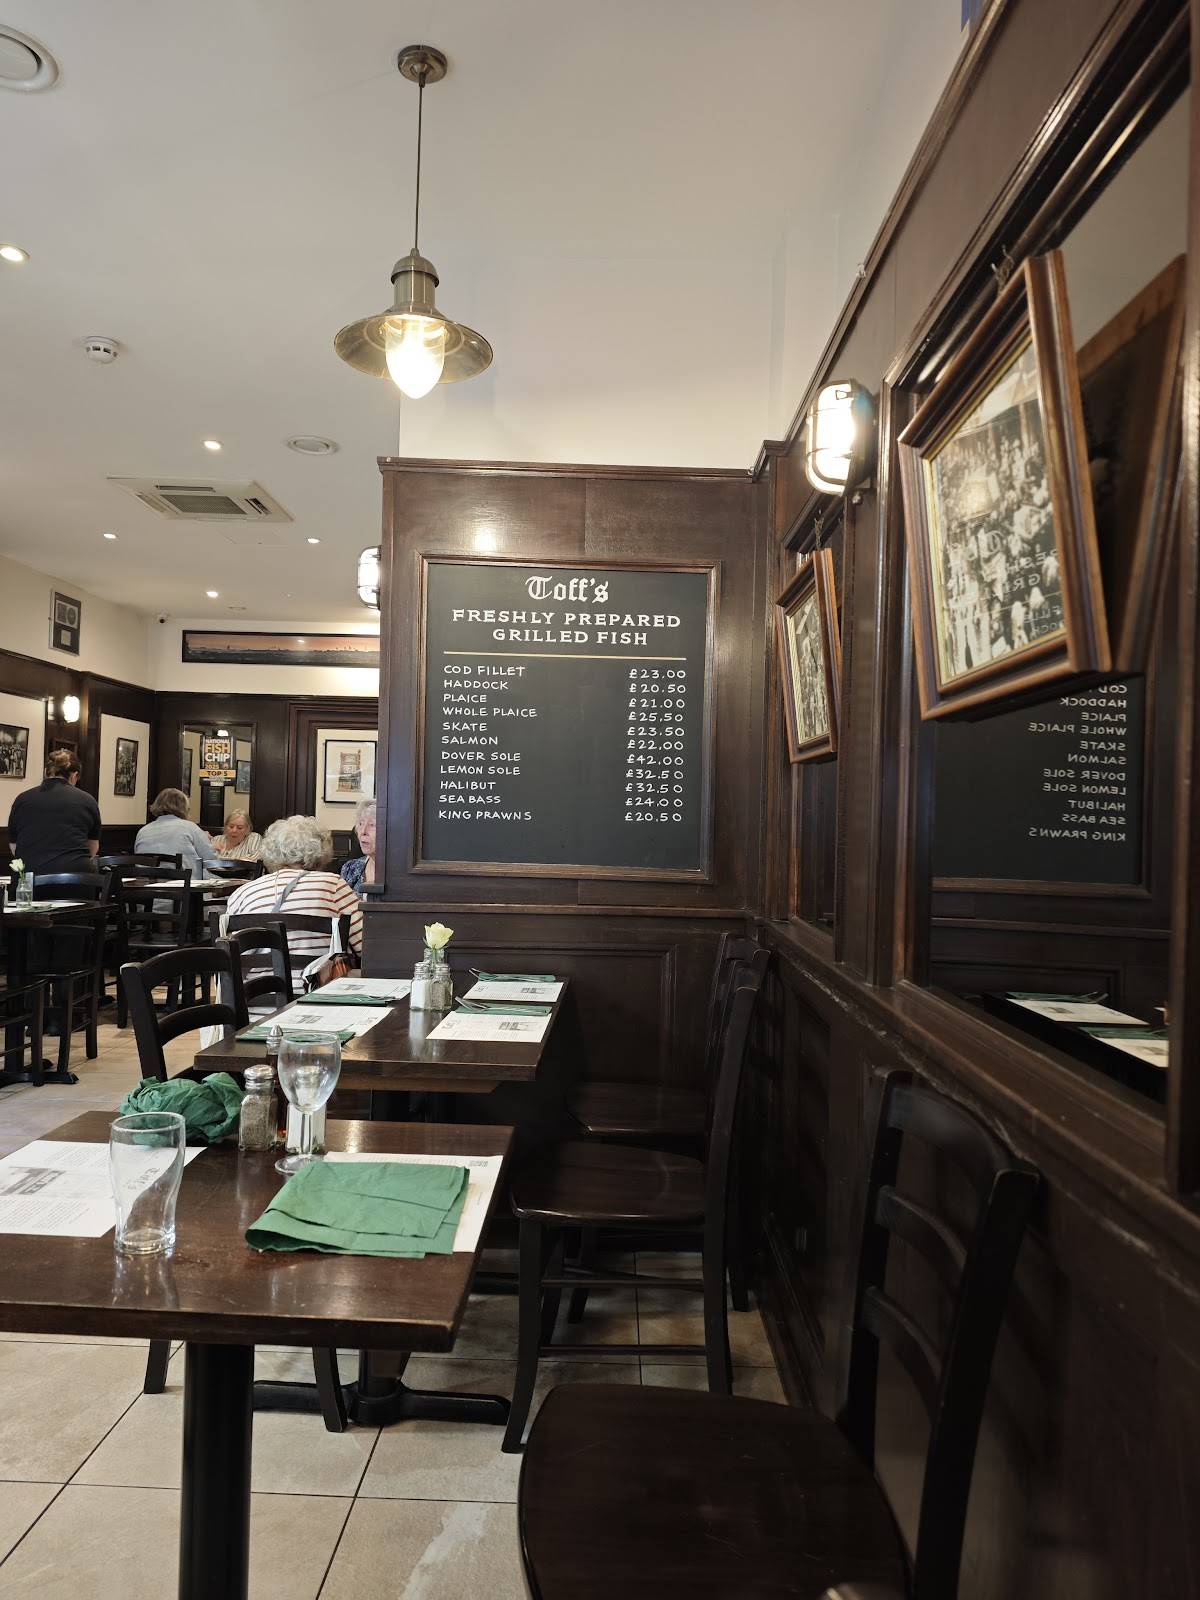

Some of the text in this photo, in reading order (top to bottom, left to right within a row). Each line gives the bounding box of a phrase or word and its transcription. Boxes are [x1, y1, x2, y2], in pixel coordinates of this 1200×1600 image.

[525, 576, 608, 603] Toff's
[452, 609, 680, 627] FRESHLY PREPARED
[493, 629, 647, 645] GRILLED FISH
[444, 665, 525, 676] COD FILLET
[629, 669, 686, 678] £23.00
[444, 680, 508, 690] HADDOCK
[629, 683, 685, 693] £20.50
[444, 694, 486, 703] PLAICE
[629, 698, 685, 708] £21.00
[443, 707, 537, 717] WHOLE PLAICE
[443, 722, 487, 731] SKATE
[627, 727, 684, 736] £23.50
[442, 736, 497, 744] SALMON
[627, 740, 683, 750] £22.00
[205, 744, 230, 753] FISH
[205, 753, 230, 762] CHIP
[442, 752, 520, 761] DOVER SOLE
[627, 754, 683, 765] £42.00
[441, 765, 520, 775] LEMON SOLE
[626, 769, 683, 779] £32.50
[441, 781, 496, 790] HALIBUT
[626, 783, 682, 793] £32.50
[439, 795, 500, 804] SEA BASS
[439, 810, 531, 820] KING PRAWNS
[625, 812, 681, 821] £20.50
